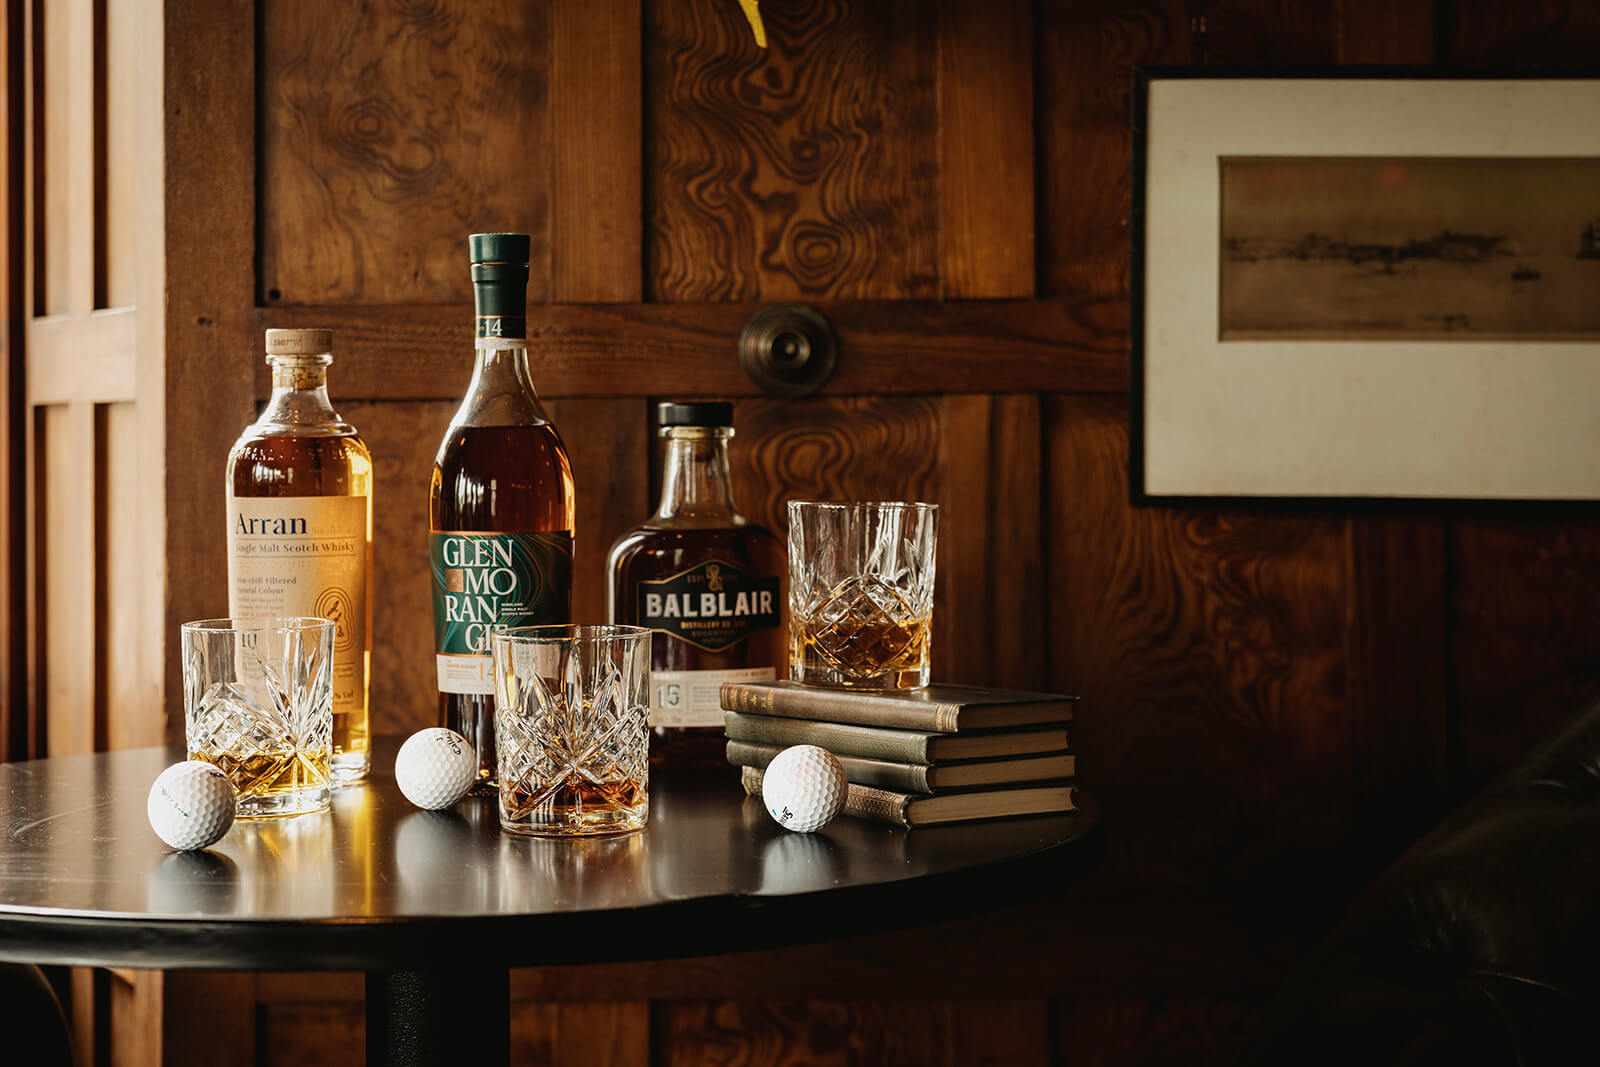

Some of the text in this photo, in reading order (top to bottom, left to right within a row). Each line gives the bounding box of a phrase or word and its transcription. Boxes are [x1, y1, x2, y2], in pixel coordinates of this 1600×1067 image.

[484, 318, 503, 337] 14
[235, 512, 308, 535] Arran
[235, 542, 355, 554] ingle Malt Scotch Whisky
[443, 537, 514, 568] GLEN
[464, 567, 518, 596] MO
[445, 595, 499, 623] RAN
[646, 590, 773, 618] BALBLAIR
[465, 623, 509, 651] GI
[655, 683, 681, 709] 15
